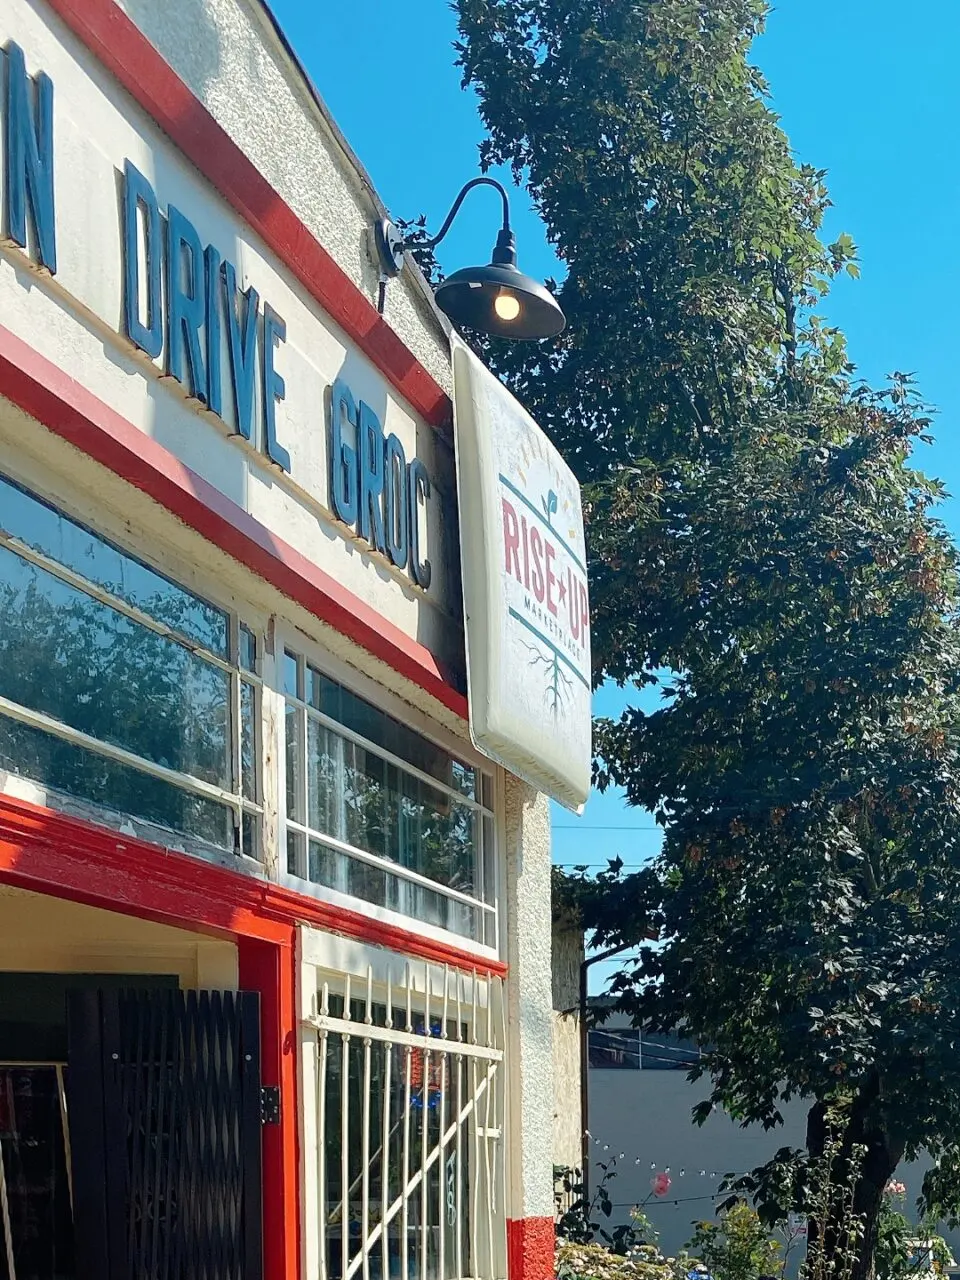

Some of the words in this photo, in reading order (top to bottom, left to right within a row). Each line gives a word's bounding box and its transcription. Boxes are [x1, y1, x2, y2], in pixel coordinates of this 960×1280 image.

[122, 157, 290, 474] DRIVE
[331, 381, 431, 589] GROC
[501, 497, 558, 617] RISE
[566, 566, 589, 649] UP
